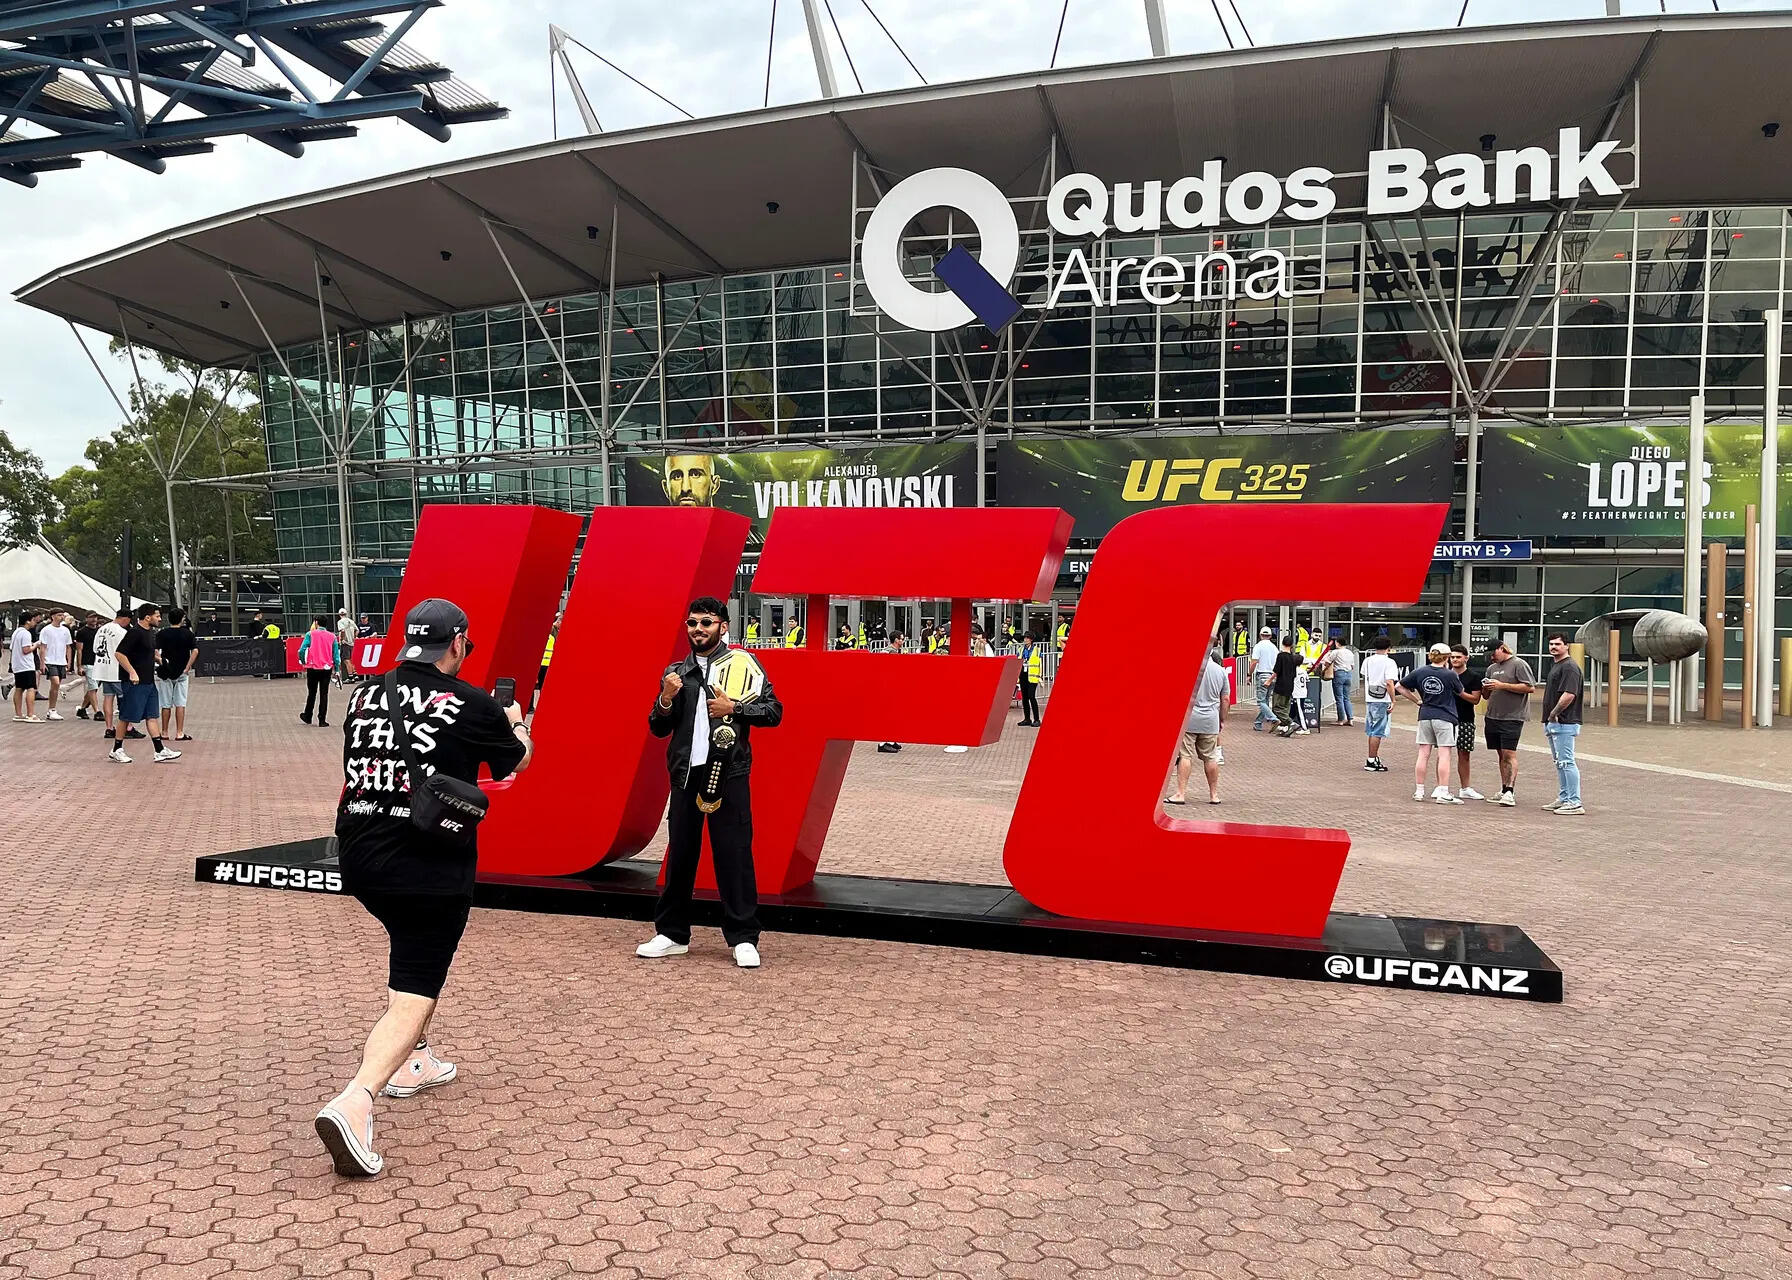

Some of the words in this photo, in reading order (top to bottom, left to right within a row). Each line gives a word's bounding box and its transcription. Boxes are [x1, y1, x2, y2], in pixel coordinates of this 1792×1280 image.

[1046, 159, 1337, 237] Qudos
[1367, 126, 1624, 216] Bank
[1046, 248, 1295, 309] Arena
[1631, 446, 1671, 460] DIEGO
[824, 464, 878, 477] ALEXANDER
[1121, 457, 1243, 501] UFC
[1240, 463, 1311, 492] 325
[754, 474, 954, 519] VOLKANOVSKI
[1562, 511, 1578, 520] #2
[1582, 510, 1670, 520] FEATHERWEIGHT
[1675, 510, 1736, 520] COENDER
[1433, 545, 1482, 557] ENTRY
[1486, 545, 1496, 556] B
[407, 624, 430, 635] UFC
[388, 502, 1450, 938] UFC
[440, 818, 463, 833] UFC
[213, 862, 343, 892] #UFC325
[1324, 955, 1530, 994] @UFCANZ
